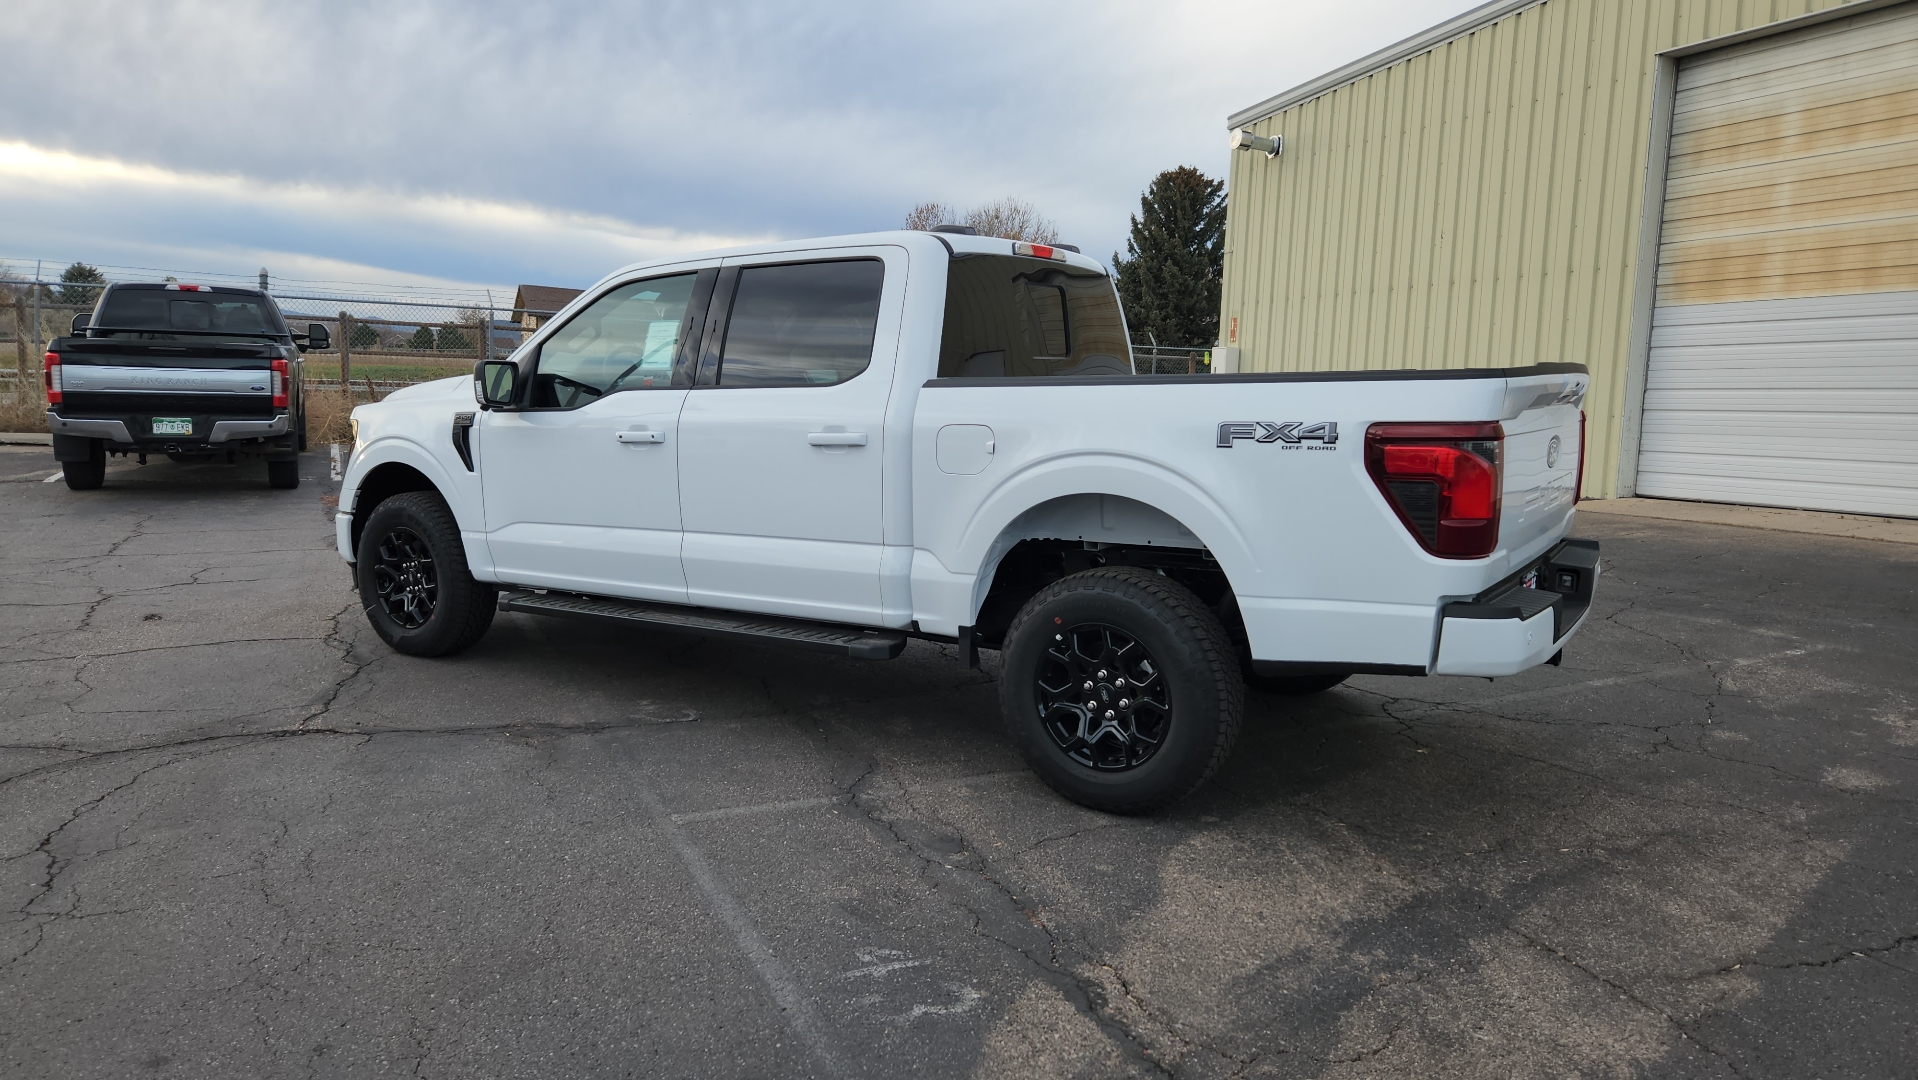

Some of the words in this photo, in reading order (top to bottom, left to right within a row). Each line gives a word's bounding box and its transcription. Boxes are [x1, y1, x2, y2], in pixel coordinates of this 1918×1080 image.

[131, 376, 162, 386] KING
[167, 377, 208, 387] RANCH
[1217, 421, 1338, 448] FX4
